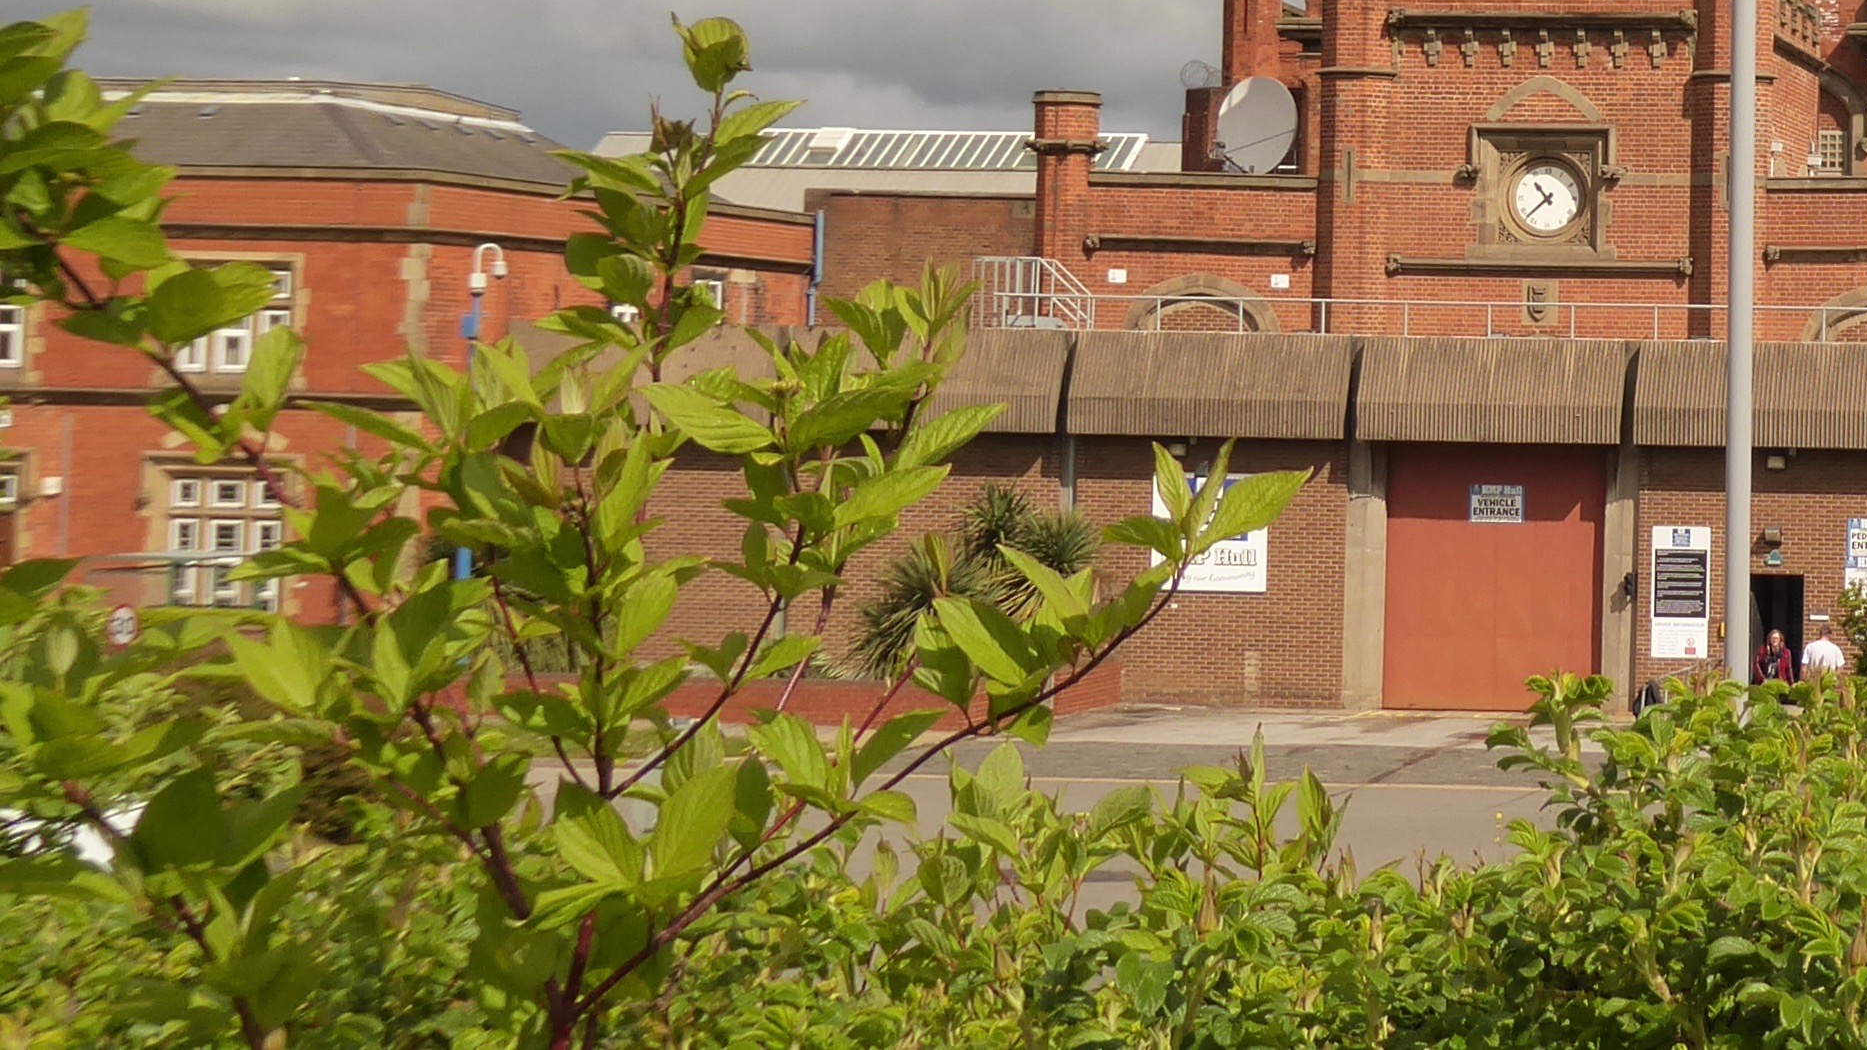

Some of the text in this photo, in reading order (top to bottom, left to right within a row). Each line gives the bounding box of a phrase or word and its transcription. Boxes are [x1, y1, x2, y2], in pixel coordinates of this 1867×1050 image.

[1477, 499, 1516, 507] VEHICLE
[1473, 507, 1520, 516] ENTRANCE
[1214, 549, 1257, 566] Hull
